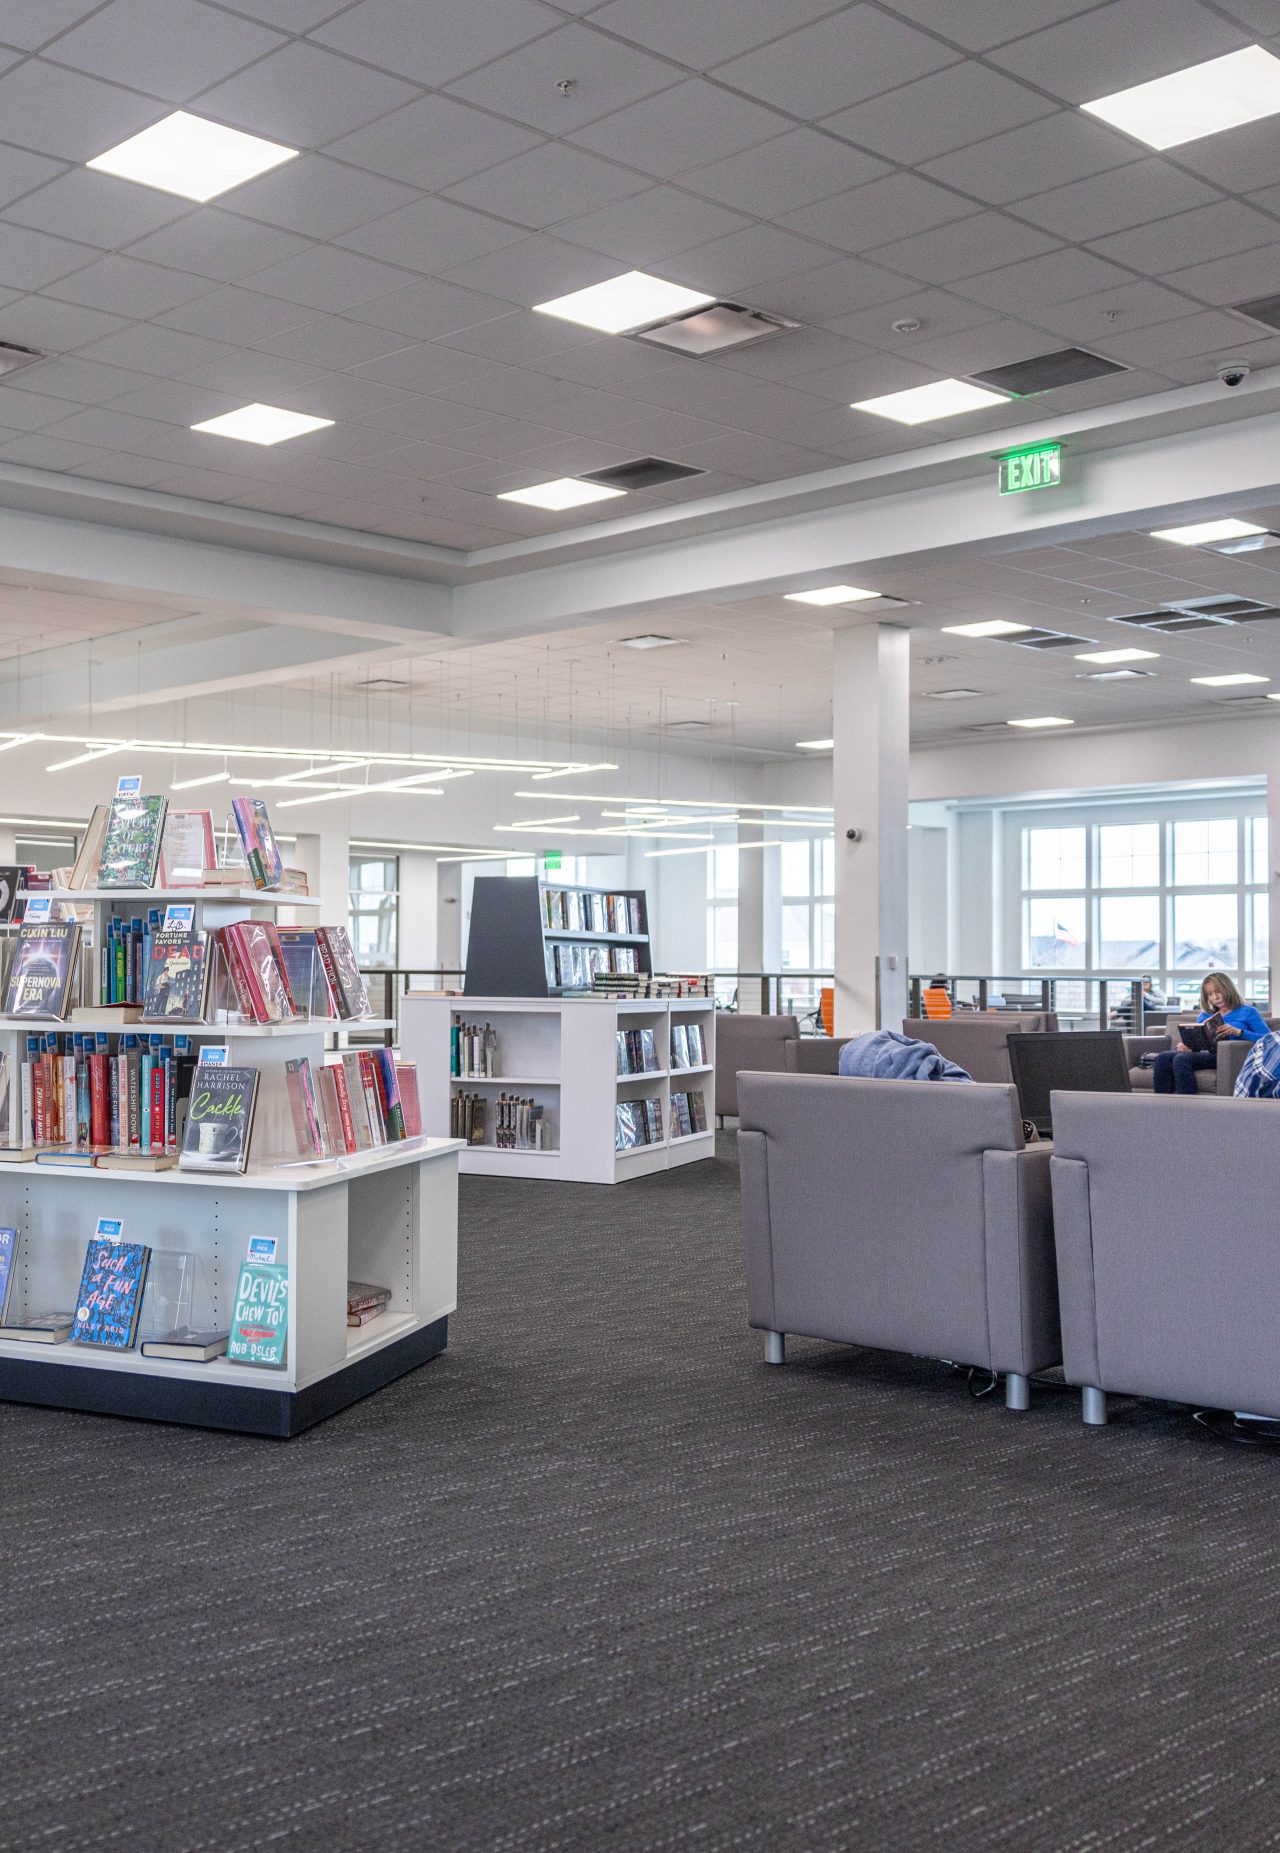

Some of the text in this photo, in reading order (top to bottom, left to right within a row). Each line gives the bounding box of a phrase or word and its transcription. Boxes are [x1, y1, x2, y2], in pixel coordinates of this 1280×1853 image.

[1007, 450, 1054, 490] EXIT
[20, 928, 68, 938] CIXIN LIU
[152, 945, 204, 959] DEAD
[319, 942, 336, 985] BRAD THOR
[10, 976, 61, 988] SUPERNOVA
[23, 988, 43, 1001] ERA
[196, 1082, 246, 1090] HARRISON
[204, 1073, 241, 1082] RACHEL
[190, 1092, 243, 1120] Cackle
[103, 1275, 135, 1295] FUN
[239, 1272, 288, 1307] DEVIL'S
[86, 1290, 117, 1311] AGE
[235, 1301, 286, 1326] CHEW TOY
[77, 1322, 101, 1331] KILEY
[230, 1341, 277, 1358] ROB OSLER
